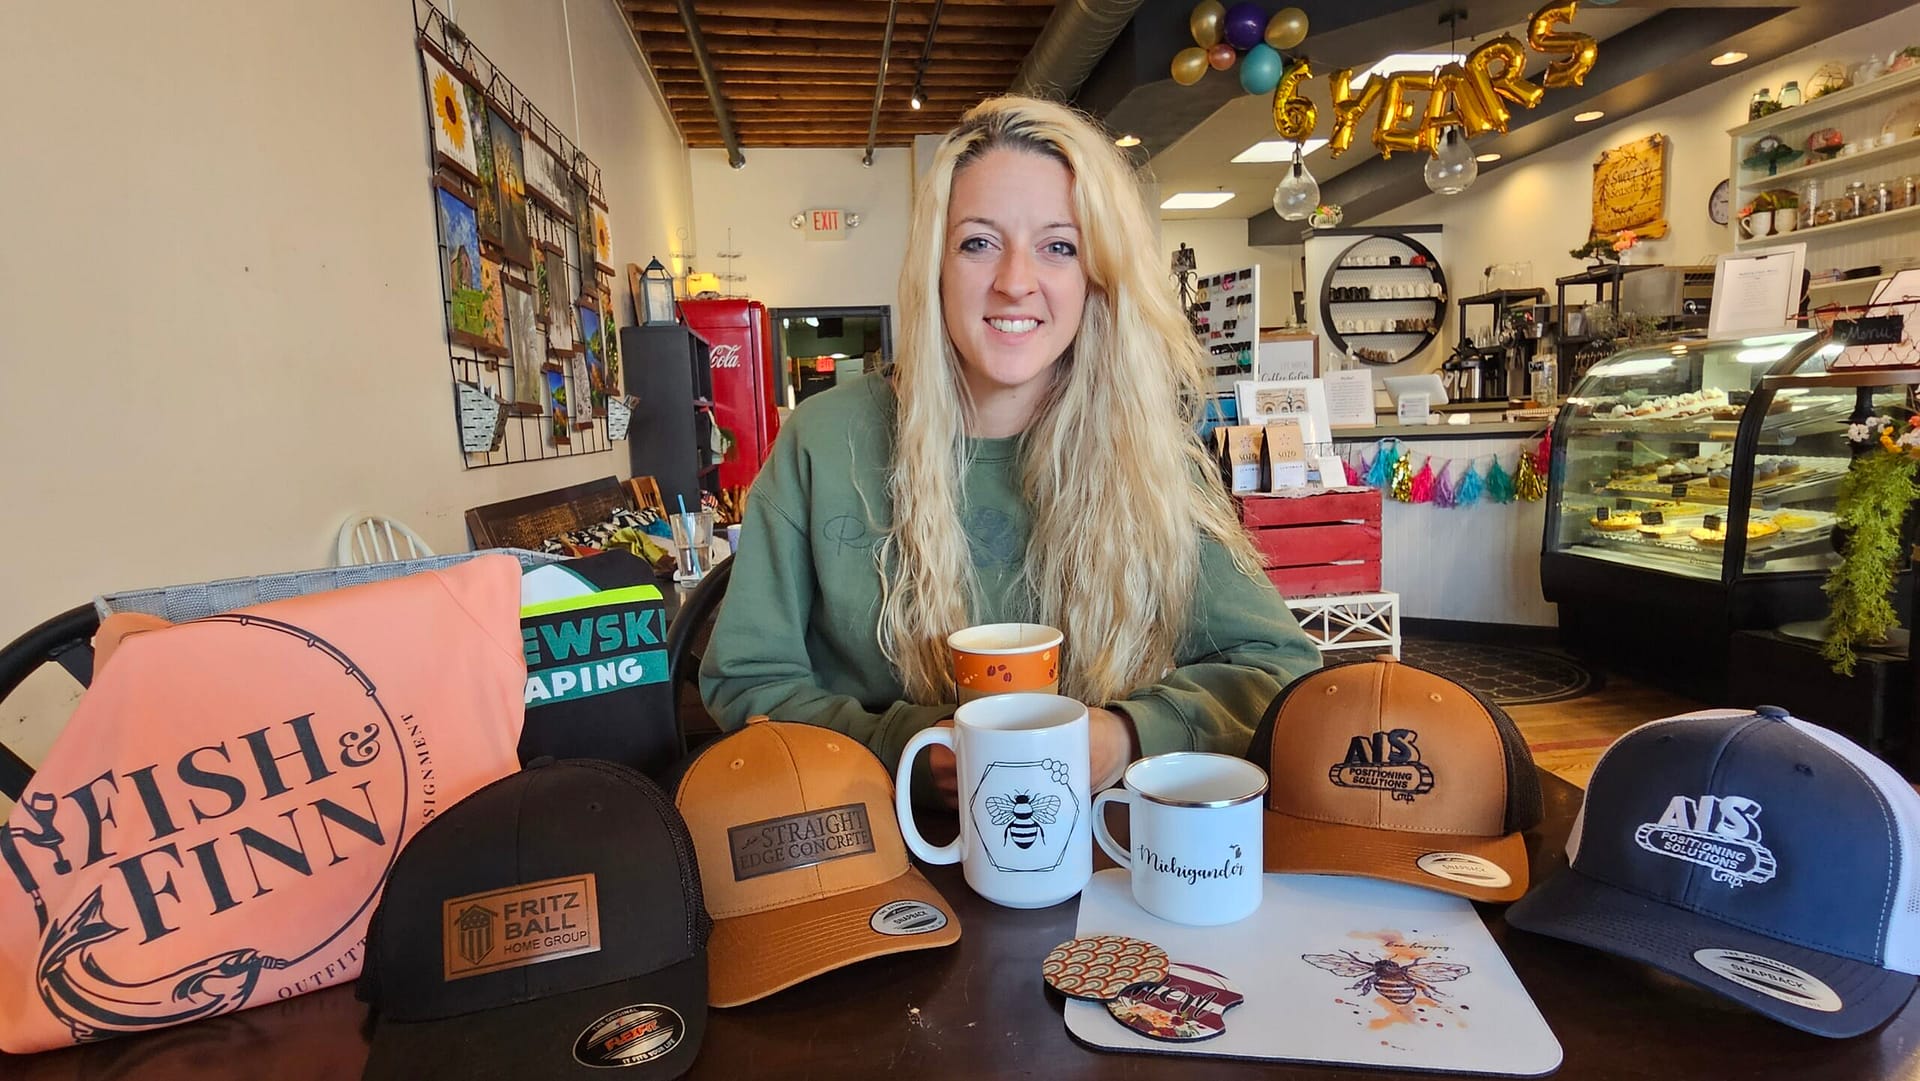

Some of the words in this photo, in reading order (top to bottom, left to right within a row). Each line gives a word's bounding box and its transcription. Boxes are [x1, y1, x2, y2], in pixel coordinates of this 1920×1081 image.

[1328, 0, 1599, 161] YEARS
[813, 211, 839, 231] EXIT
[1841, 326, 1893, 340] Menu
[524, 657, 643, 704] APING
[1343, 728, 1421, 766] AIS
[400, 713, 436, 825] SIGNMENT
[1349, 766, 1413, 781] POSITIONING
[1352, 776, 1409, 789] SOLUTIONS
[62, 712, 337, 871] FISH
[338, 722, 381, 768] &
[761, 810, 864, 850] STRAIGHT
[1657, 795, 1762, 843] AIS
[109, 780, 386, 946] FINN
[740, 848, 785, 871] EDGE
[788, 830, 869, 860] CONCRETE
[1660, 830, 1747, 863] POSITIONING
[1663, 840, 1740, 870] SOLUTIONS
[1137, 844, 1243, 885] Michigander
[503, 891, 580, 921] FRITZ
[503, 939, 541, 955] HOME
[544, 930, 588, 948] GROUP
[505, 913, 577, 941] BALL
[1731, 963, 1806, 991] SNAPBACK
